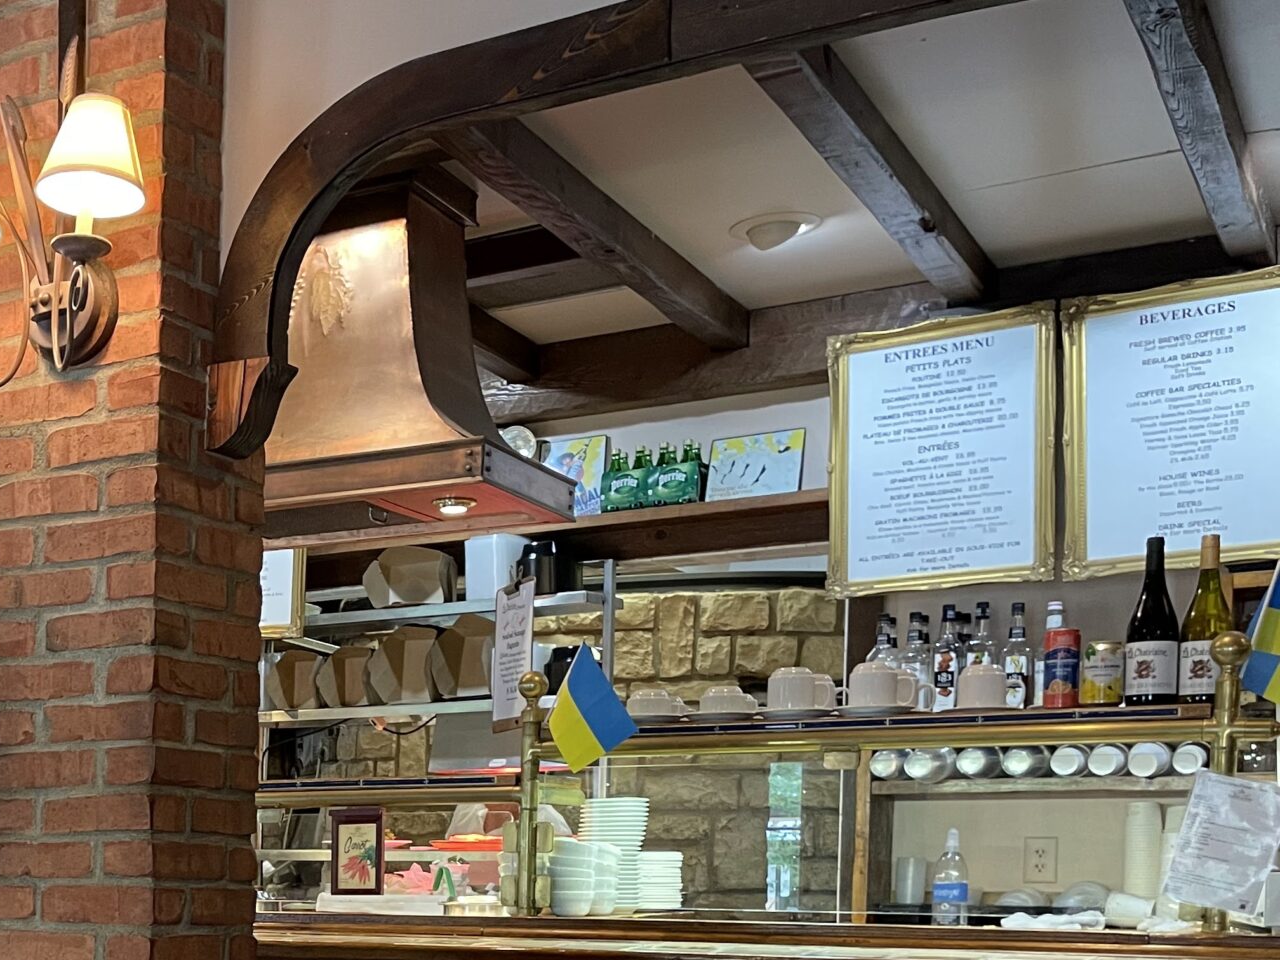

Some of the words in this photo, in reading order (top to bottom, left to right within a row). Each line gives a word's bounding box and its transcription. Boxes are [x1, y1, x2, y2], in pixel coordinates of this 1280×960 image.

[1139, 301, 1236, 325] BEVERAGES
[1129, 338, 1155, 348] FRESH
[1158, 334, 1191, 344] BREWED
[1195, 328, 1225, 338] COFFEE
[884, 343, 948, 363] ENTREES
[952, 336, 994, 353] MENU
[1142, 355, 1177, 365] REGULAR
[1181, 350, 1212, 360] DRINKS
[905, 360, 939, 373] PETITS
[942, 357, 971, 368] PLATS
[1136, 388, 1165, 398] COFFEE
[1168, 385, 1184, 393] BAR
[1188, 378, 1241, 391] SPECIALTIES
[918, 441, 959, 454] ENTRÉES
[1159, 472, 1187, 481] HOUSE
[1191, 468, 1220, 477] WINES
[1159, 522, 1184, 530] DRINK
[1188, 519, 1221, 527] SPECIAL
